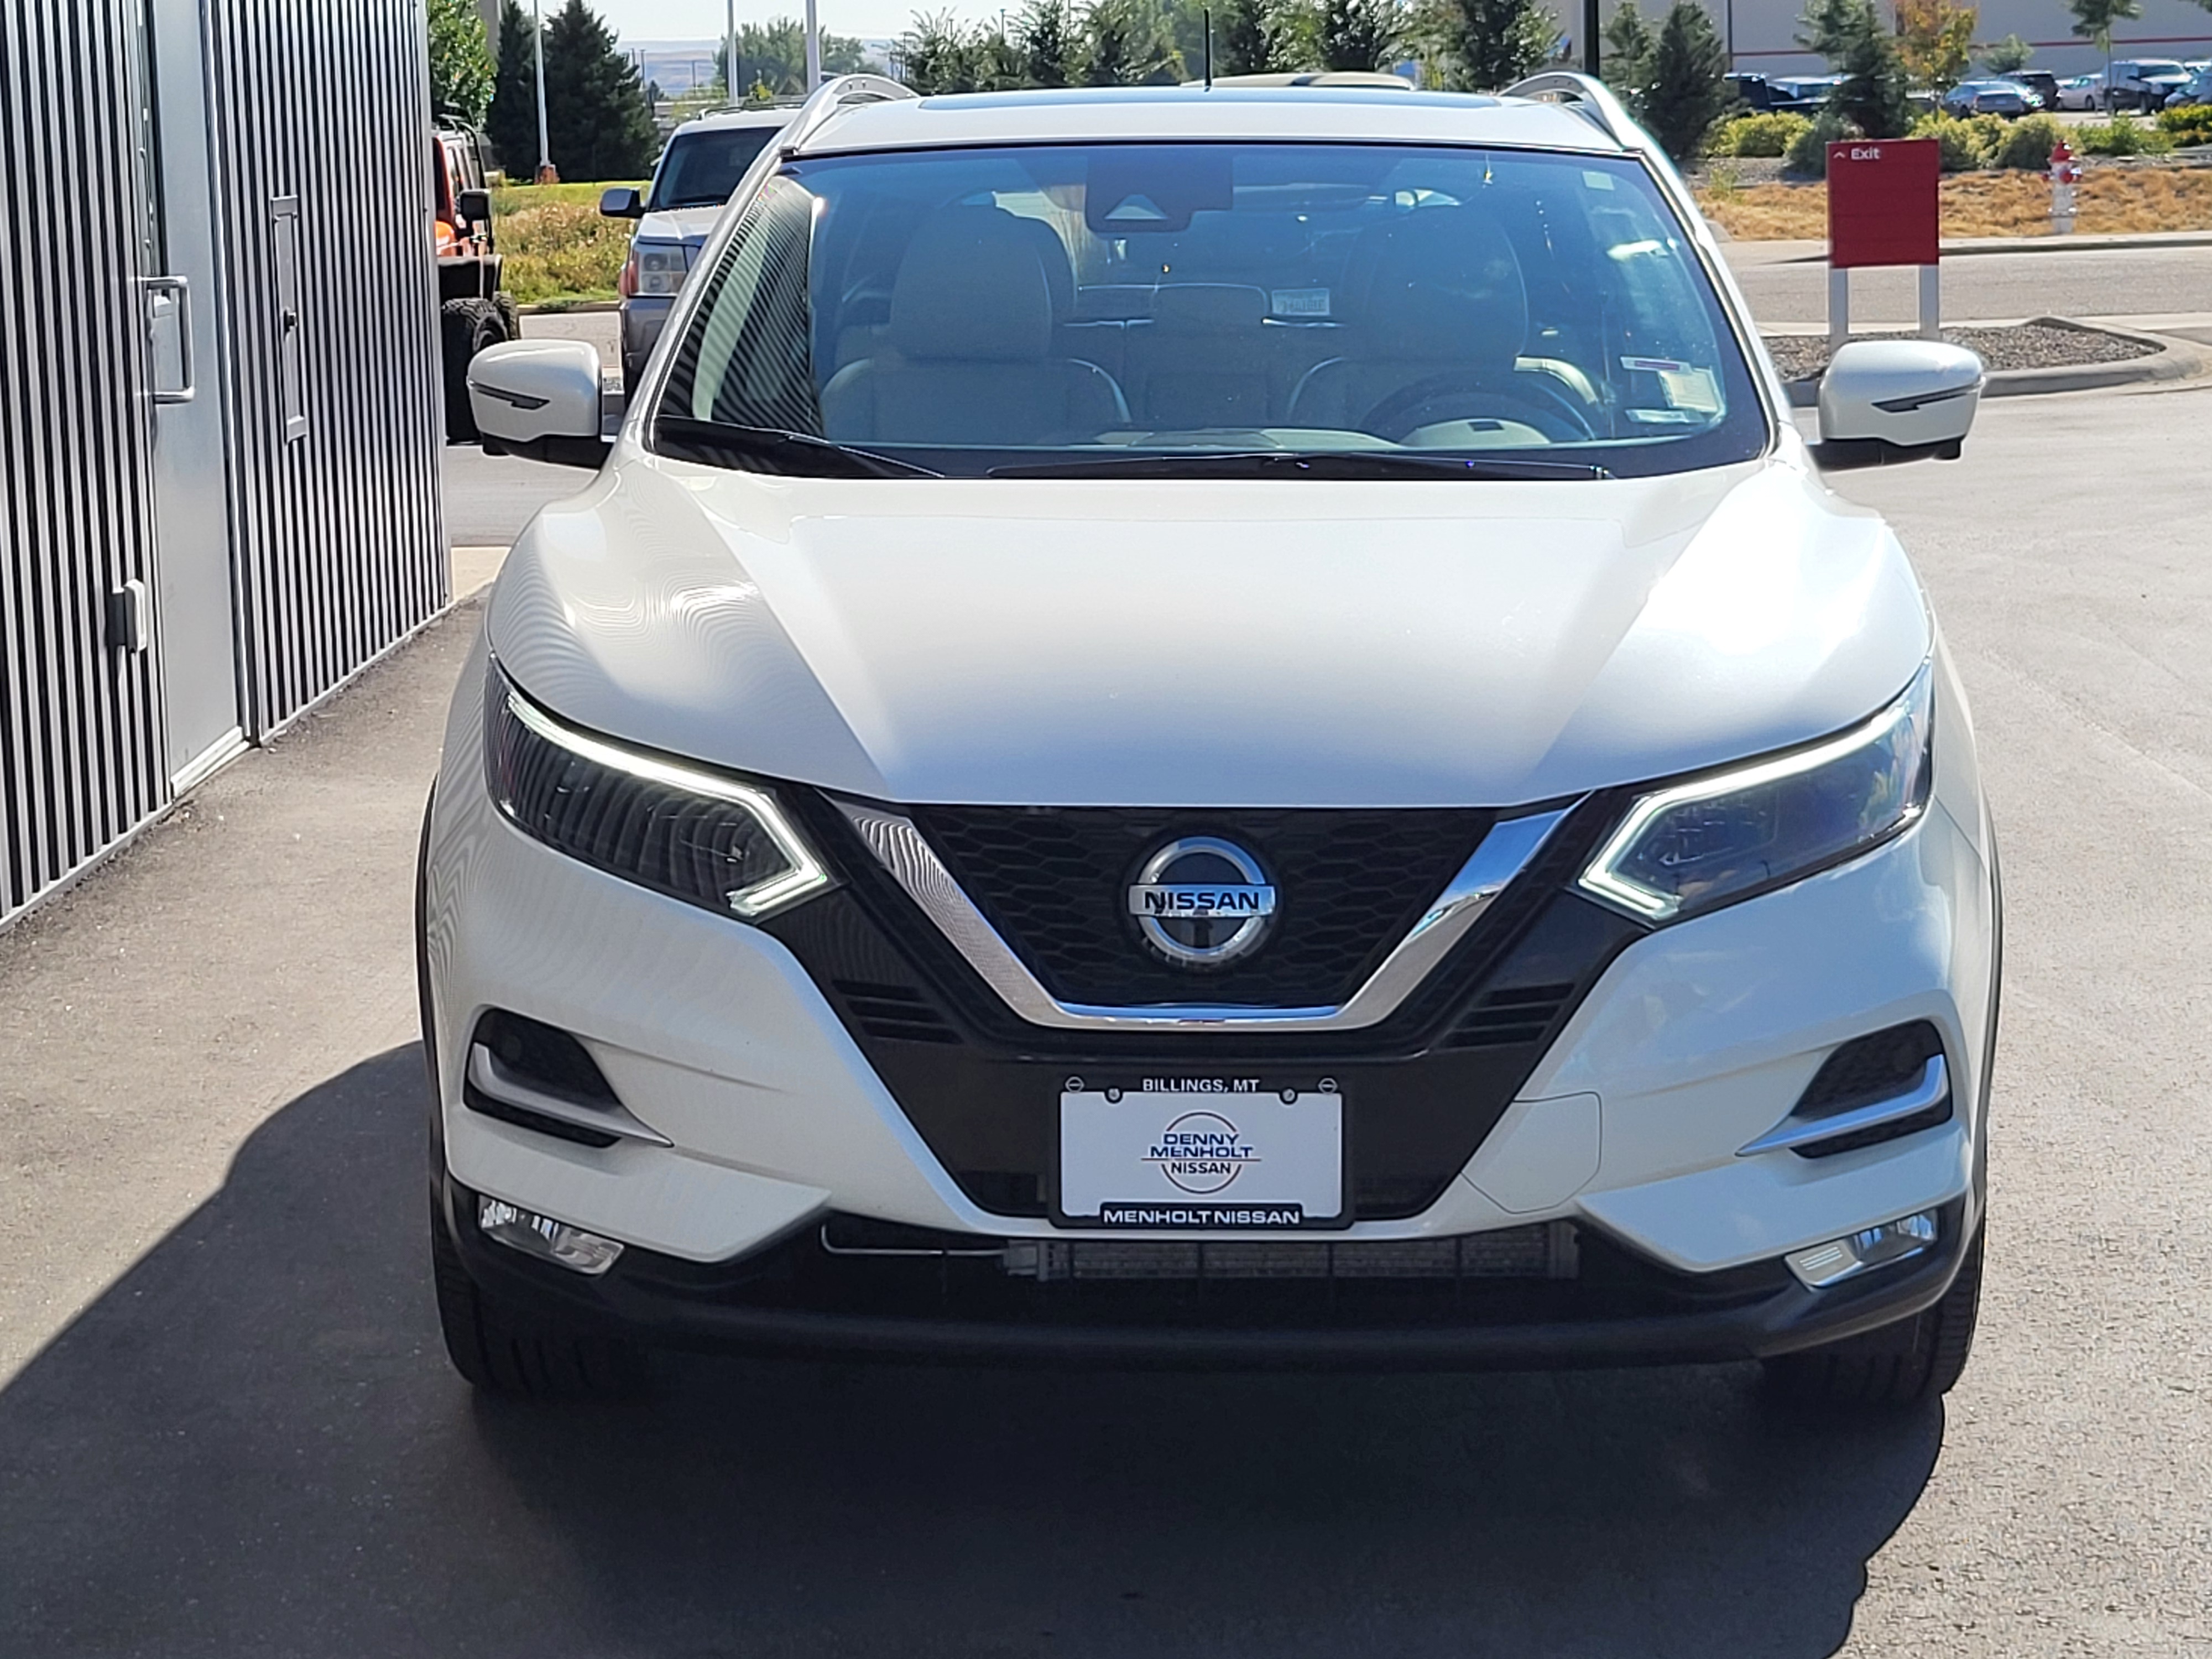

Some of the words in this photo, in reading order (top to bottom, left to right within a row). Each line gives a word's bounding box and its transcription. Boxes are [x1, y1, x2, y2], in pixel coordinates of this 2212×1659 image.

[1851, 147, 1880, 160] Exit
[1144, 891, 1259, 910] NISSAN
[1142, 1078, 1229, 1093] BILLINGS,
[1234, 1079, 1260, 1092] MT
[1164, 1133, 1240, 1145] DENNY
[1150, 1146, 1254, 1157] MENHOLT
[1170, 1162, 1232, 1175] NISSAN
[1103, 1209, 1211, 1224] MENHOLT
[1214, 1210, 1300, 1224] NISSAN
